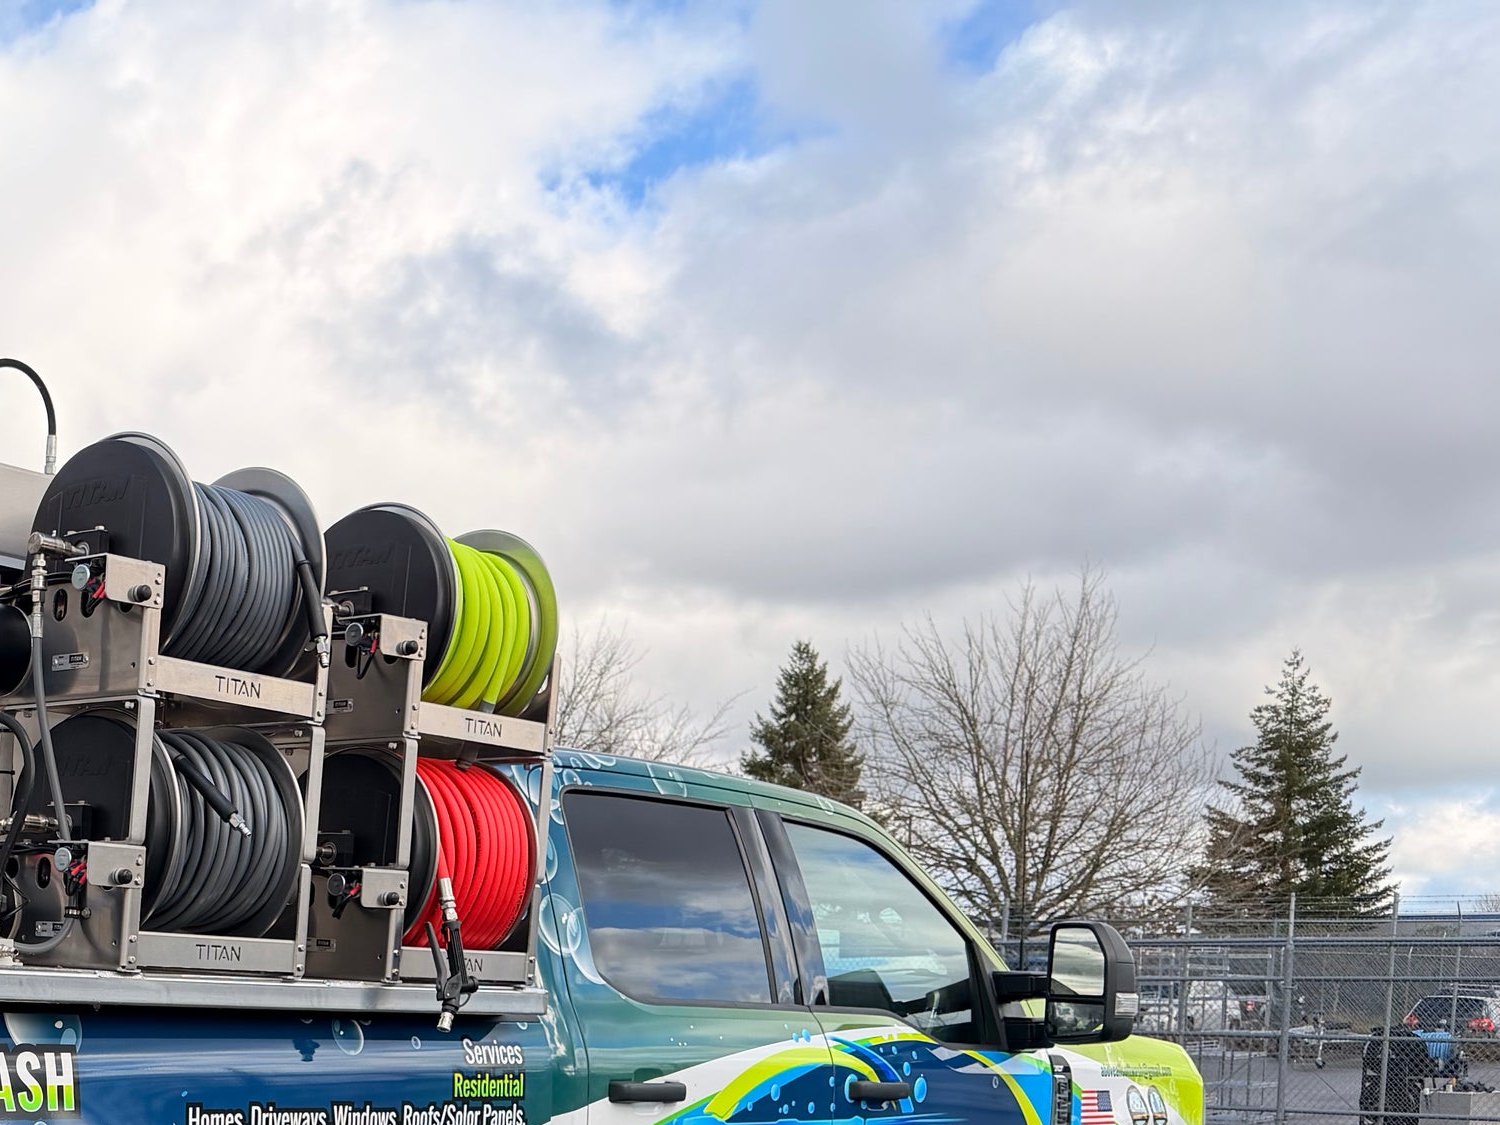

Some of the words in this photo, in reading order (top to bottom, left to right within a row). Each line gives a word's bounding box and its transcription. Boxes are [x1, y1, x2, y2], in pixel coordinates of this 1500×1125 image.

[215, 675, 261, 699] TITAN
[465, 717, 503, 738] TITAN
[195, 944, 241, 961] TITAN
[463, 1038, 524, 1065] Services
[454, 1073, 524, 1098] Residential
